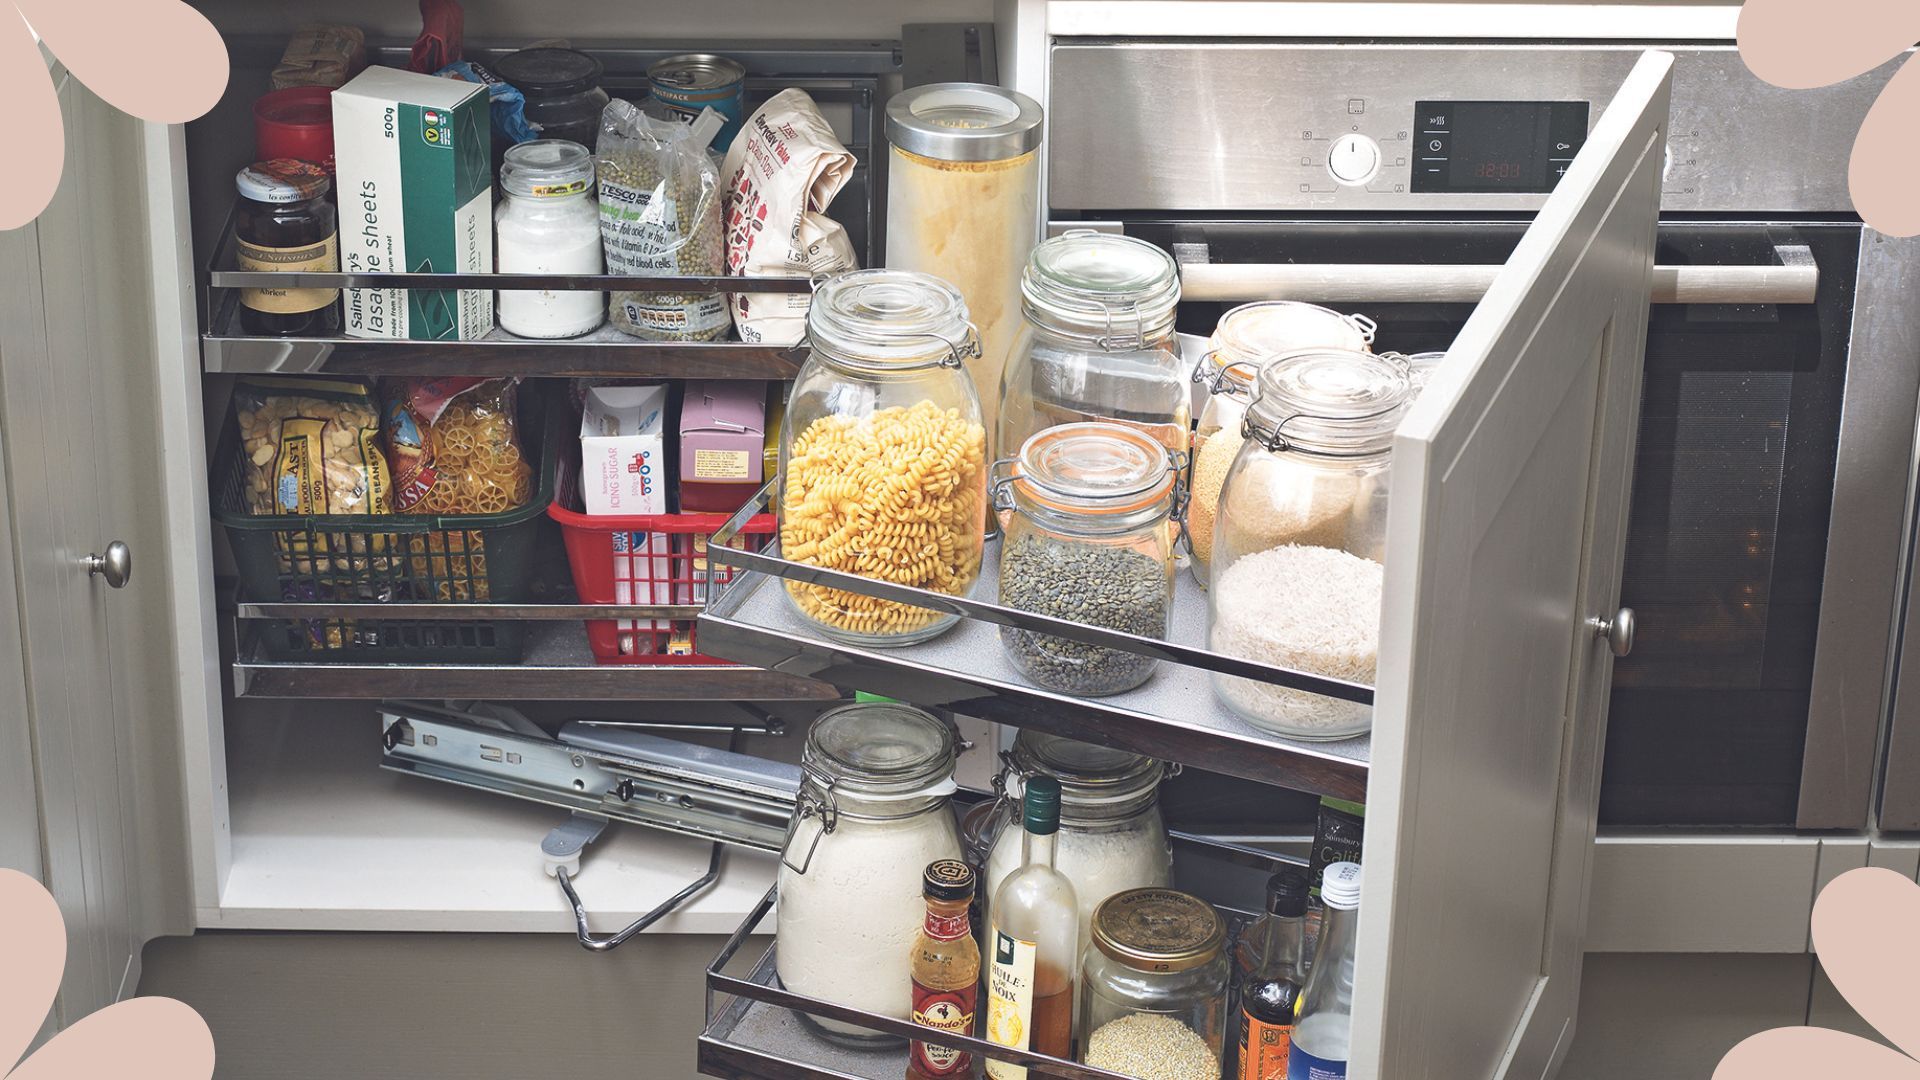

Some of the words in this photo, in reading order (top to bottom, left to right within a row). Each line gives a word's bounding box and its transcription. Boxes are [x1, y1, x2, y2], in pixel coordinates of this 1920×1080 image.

[652, 87, 689, 101] MULTIPACK
[384, 107, 395, 139] 500g
[754, 113, 778, 149] Everyday
[775, 142, 791, 166] Value
[761, 154, 775, 181] flour
[602, 183, 636, 201] TESCO
[360, 180, 378, 248] sheets
[467, 214, 476, 271] sheets
[636, 256, 653, 269] blood
[260, 288, 287, 297] Abricot
[347, 252, 363, 330] Sainsby's
[366, 255, 385, 334] lasae
[389, 300, 397, 317] from
[740, 323, 761, 343] 1.5kg
[299, 440, 308, 481] PRODUCTS
[608, 447, 619, 480] SUGAR
[372, 461, 382, 494] BEANS
[301, 481, 310, 504] FOOD
[313, 480, 322, 501] 500g
[610, 482, 621, 509] ICING
[1324, 832, 1360, 848] Sainsbury
[1320, 846, 1361, 864] Calif
[1121, 893, 1153, 905] SAFETY
[1155, 894, 1192, 906] BUTTON
[992, 963, 1020, 988] HUILE
[992, 980, 1016, 1002] NOIX
[921, 1015, 965, 1029] Nando's
